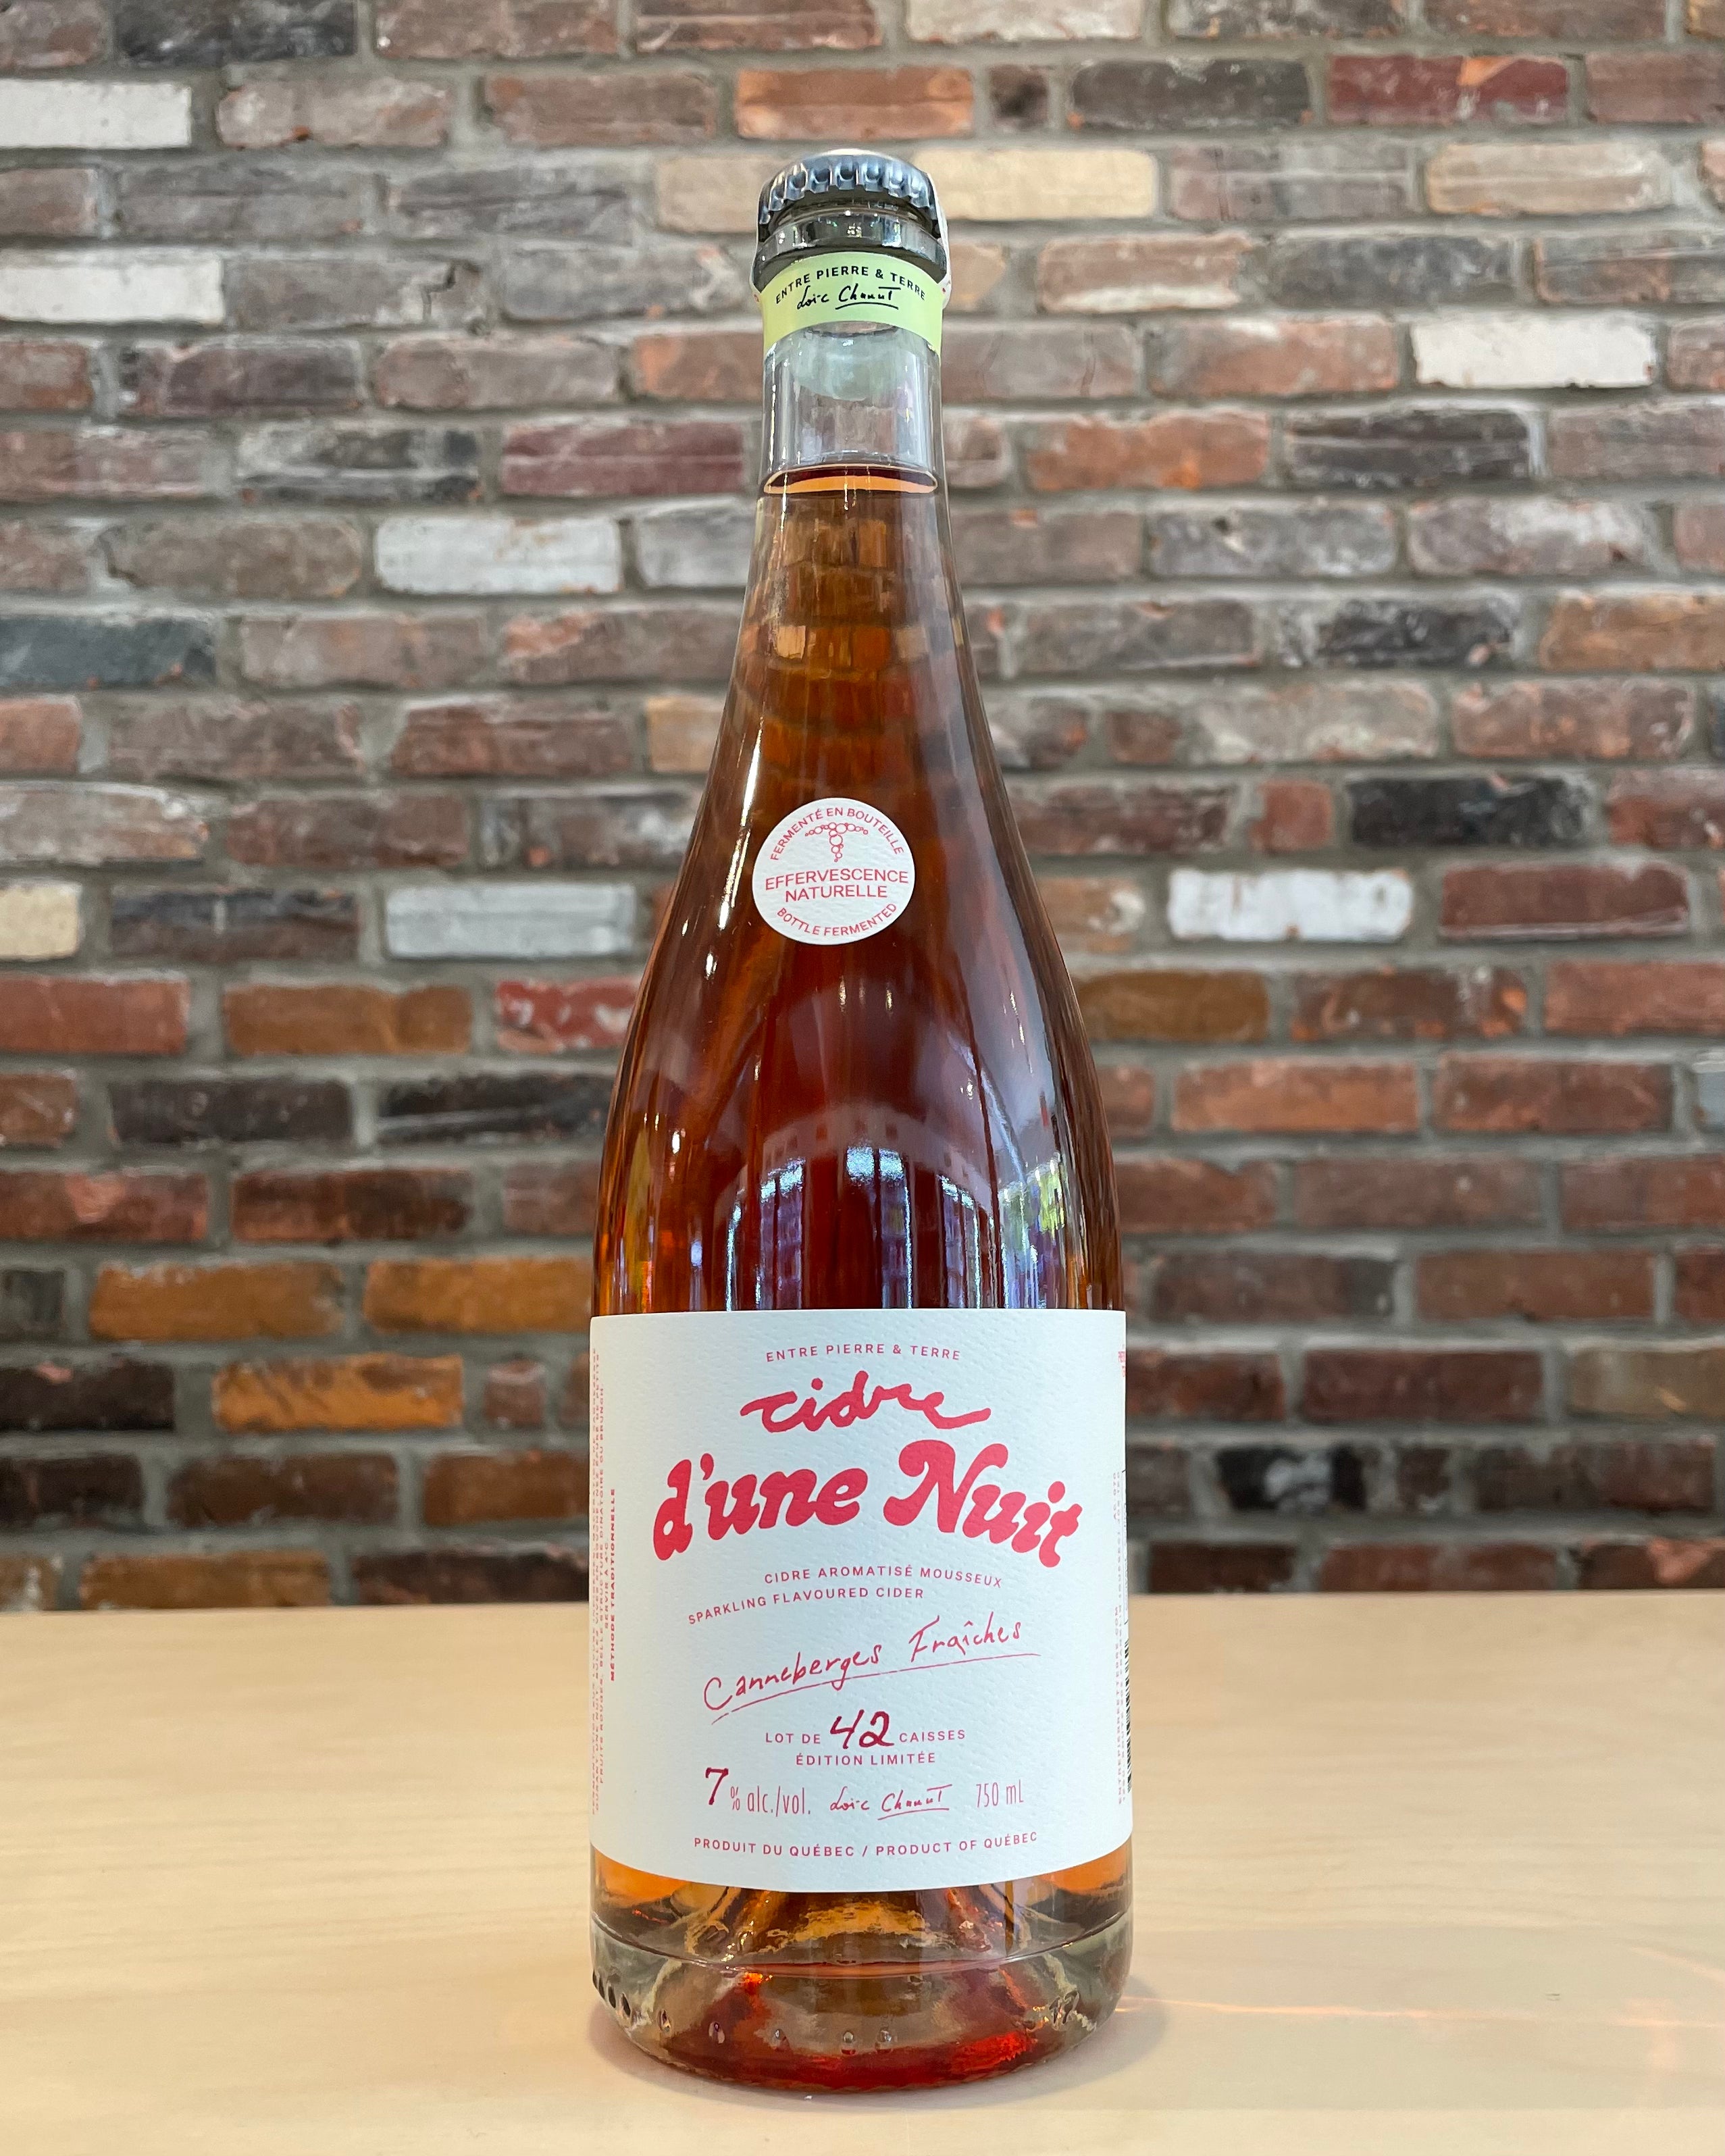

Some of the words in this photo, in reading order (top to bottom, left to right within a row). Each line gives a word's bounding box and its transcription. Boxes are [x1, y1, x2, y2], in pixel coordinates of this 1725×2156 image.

[775, 273, 811, 304] ENTRE
[816, 265, 869, 280] PIERRE
[875, 269, 884, 280] &
[890, 272, 926, 301] TERRE
[770, 808, 823, 861] FERMENTÉ
[826, 807, 844, 817] EN
[846, 808, 904, 854] BOUTEILLE
[765, 868, 908, 891] EFFERVESCENCE
[786, 885, 888, 902] NATURELLE
[777, 907, 821, 935] BOTTLE
[823, 903, 898, 936] FERMENTED
[766, 1345, 817, 1362] ENTRE
[825, 1343, 884, 1355] PIERRE
[892, 1343, 902, 1355] &
[910, 1344, 961, 1361] TERRE
[740, 1370, 992, 1434] cidre
[881, 1439, 1083, 1570] Nuit
[764, 1568, 810, 1585] CIDRE
[818, 1564, 913, 1578] AROMATISÉ
[919, 1567, 1003, 1589] MOUSSEUX
[688, 1596, 767, 1626] SPARKLING
[772, 1587, 869, 1603] FLAVOURED
[875, 1587, 924, 1599] CIDER
[702, 1643, 883, 1711] Canneberges
[908, 1612, 1023, 1663] Fraîches
[765, 1732, 794, 1744] LOT
[801, 1733, 821, 1745] DE
[829, 1709, 894, 1750] 42
[899, 1729, 966, 1743] CAISSES
[796, 1753, 863, 1766] ÉDITION
[871, 1751, 936, 1766] LIMITÉE
[747, 1785, 812, 1817] alc./vol.
[975, 1781, 1000, 1810] 750
[1006, 1779, 1025, 1805] mL
[693, 1837, 756, 1853] PRODUIT
[763, 1843, 783, 1857] DU
[788, 1842, 855, 1857] QUÉBEC
[861, 1845, 869, 1857] /
[875, 1841, 954, 1856] PRODUCT
[958, 1839, 977, 1851] OF
[983, 1830, 1038, 1849] QUÉBEC
